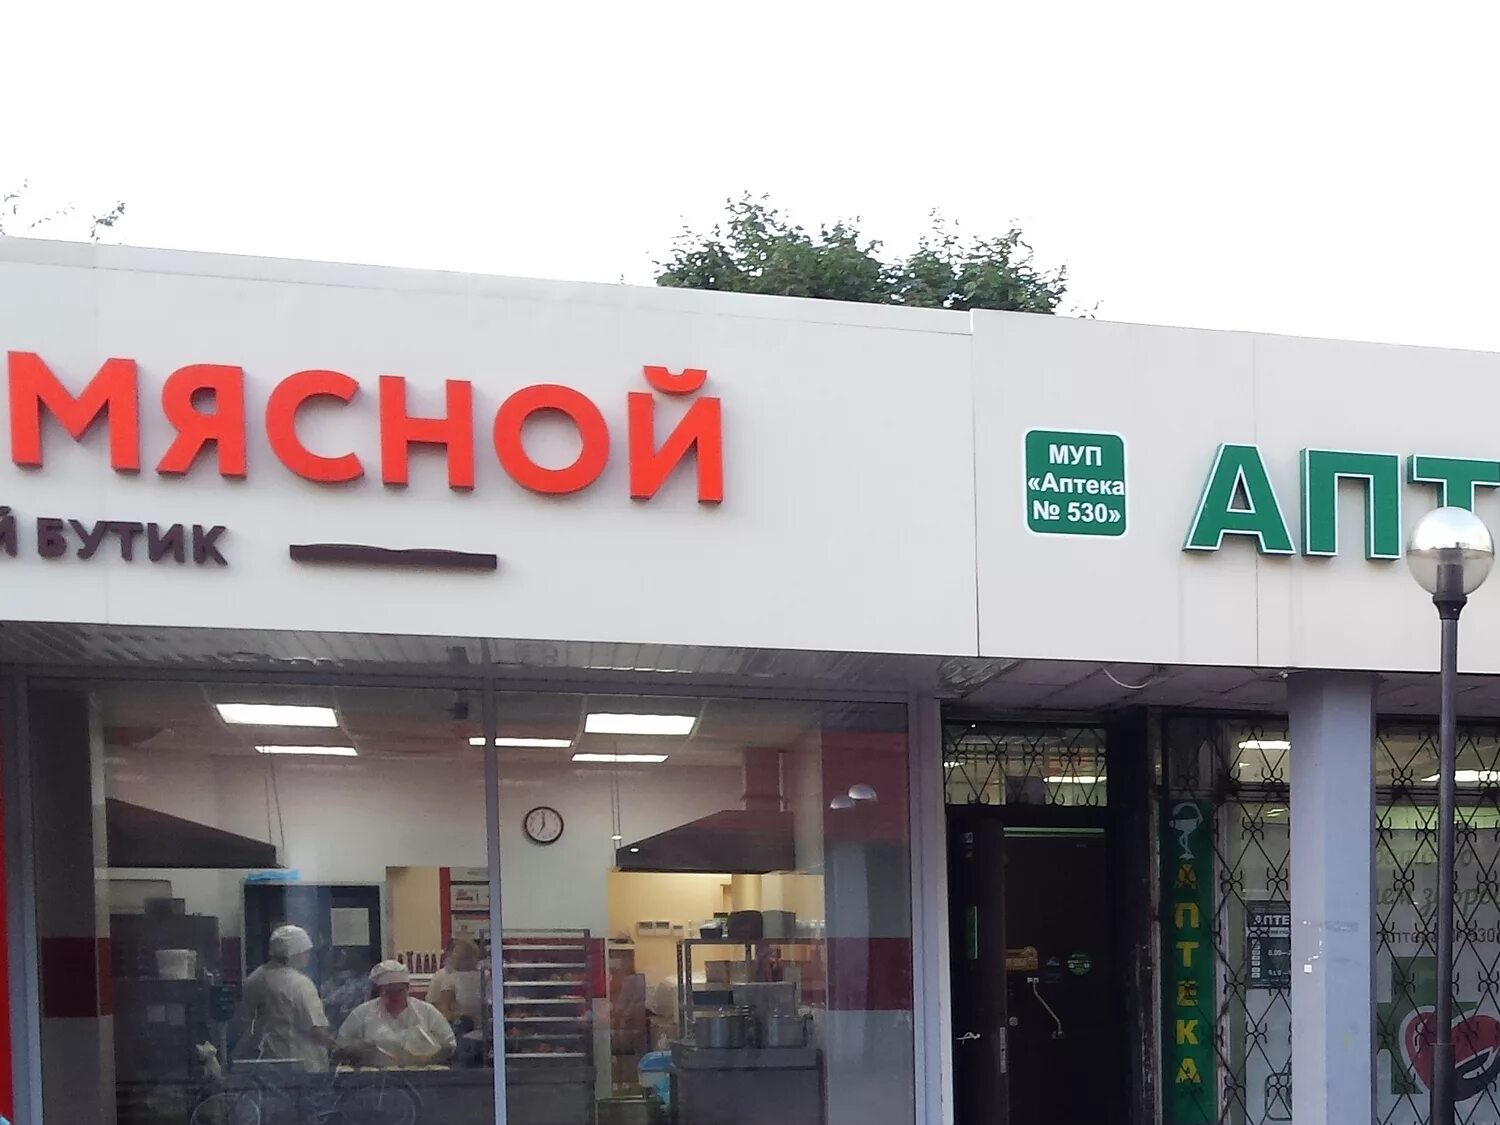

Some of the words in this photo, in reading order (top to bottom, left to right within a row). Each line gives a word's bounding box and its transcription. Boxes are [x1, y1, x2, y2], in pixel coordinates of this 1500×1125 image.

[7, 350, 724, 505] МЯСНОЙ
[1047, 443, 1103, 467] МУП
[1027, 472, 1126, 497] «Аптека
[1032, 500, 1062, 524] №
[1066, 500, 1122, 526] 530»
[36, 518, 230, 567] БУТИК
[1174, 863, 1201, 1084] АПТЕКА
